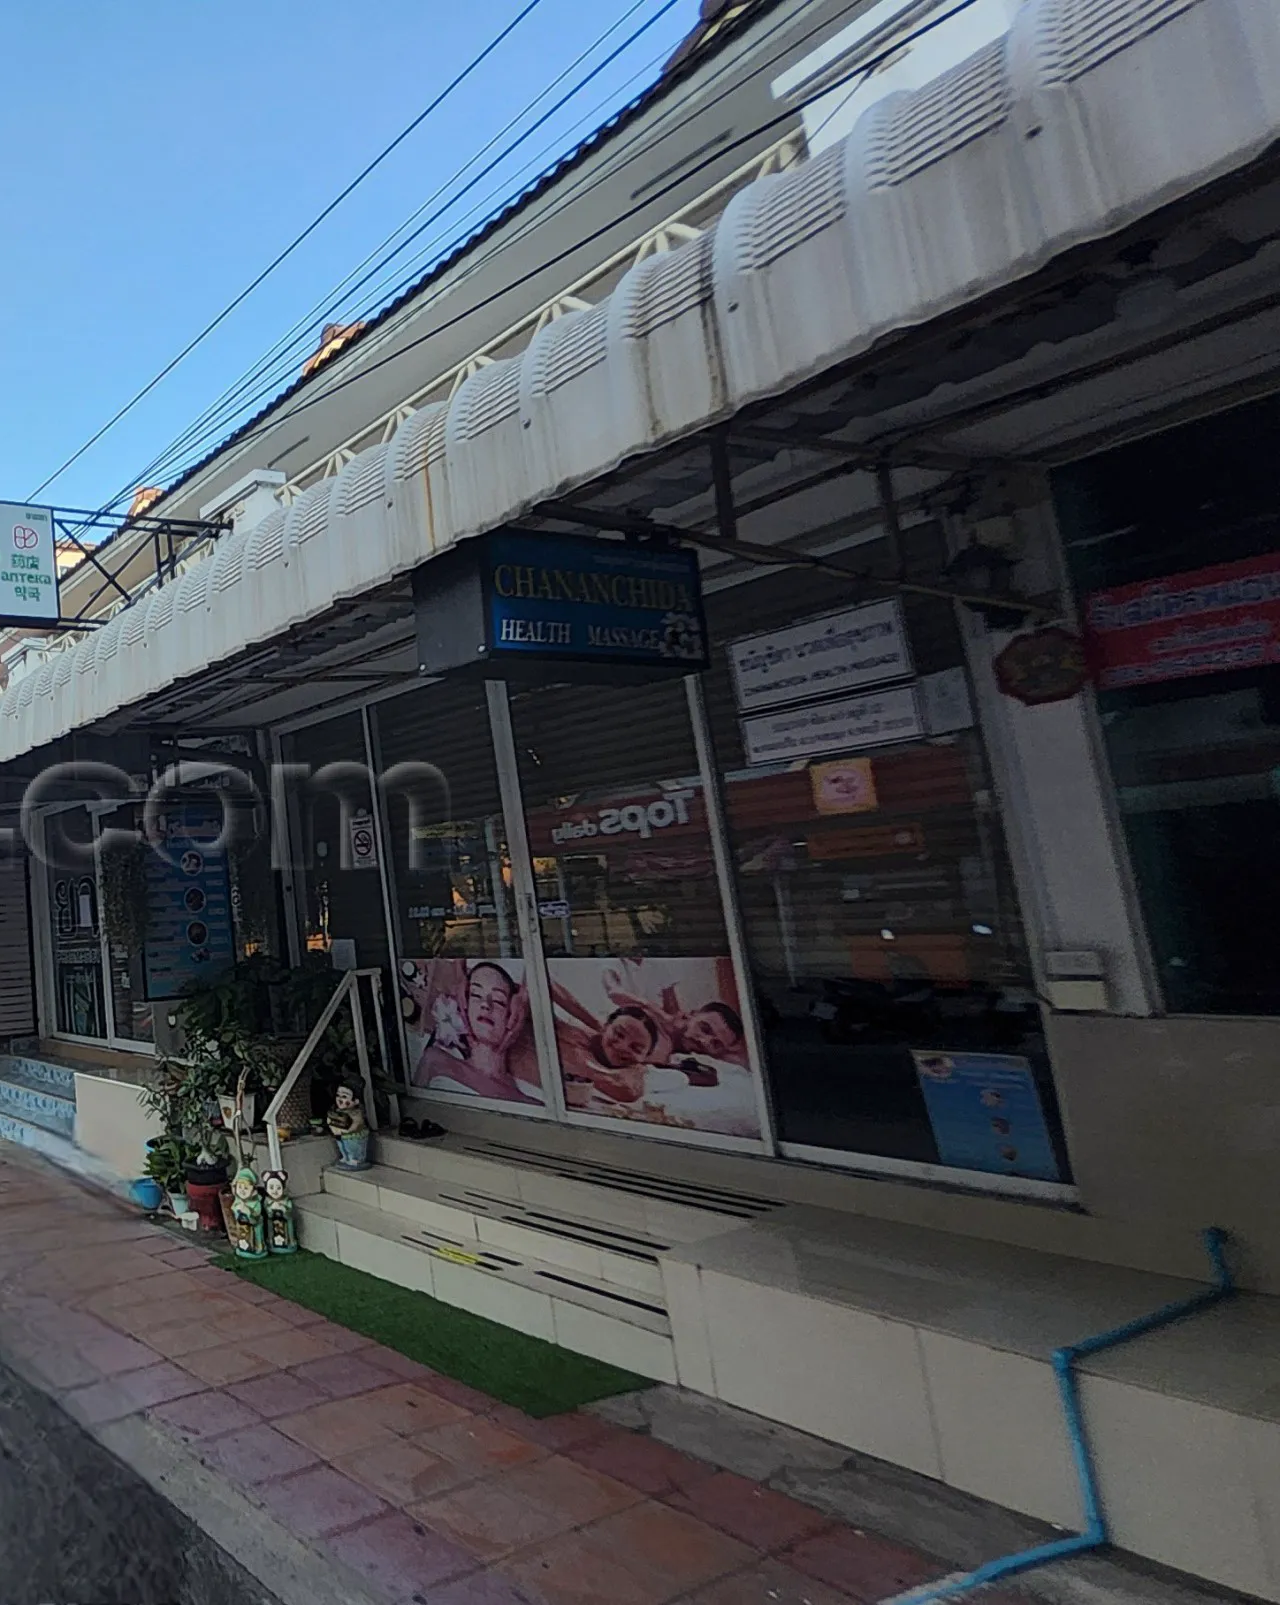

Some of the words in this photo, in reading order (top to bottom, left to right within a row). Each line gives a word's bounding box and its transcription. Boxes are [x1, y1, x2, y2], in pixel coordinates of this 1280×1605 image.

[493, 563, 694, 612] CHANANCHIDA
[500, 618, 571, 644] HEALTH
[587, 625, 661, 651] MASSAGE
